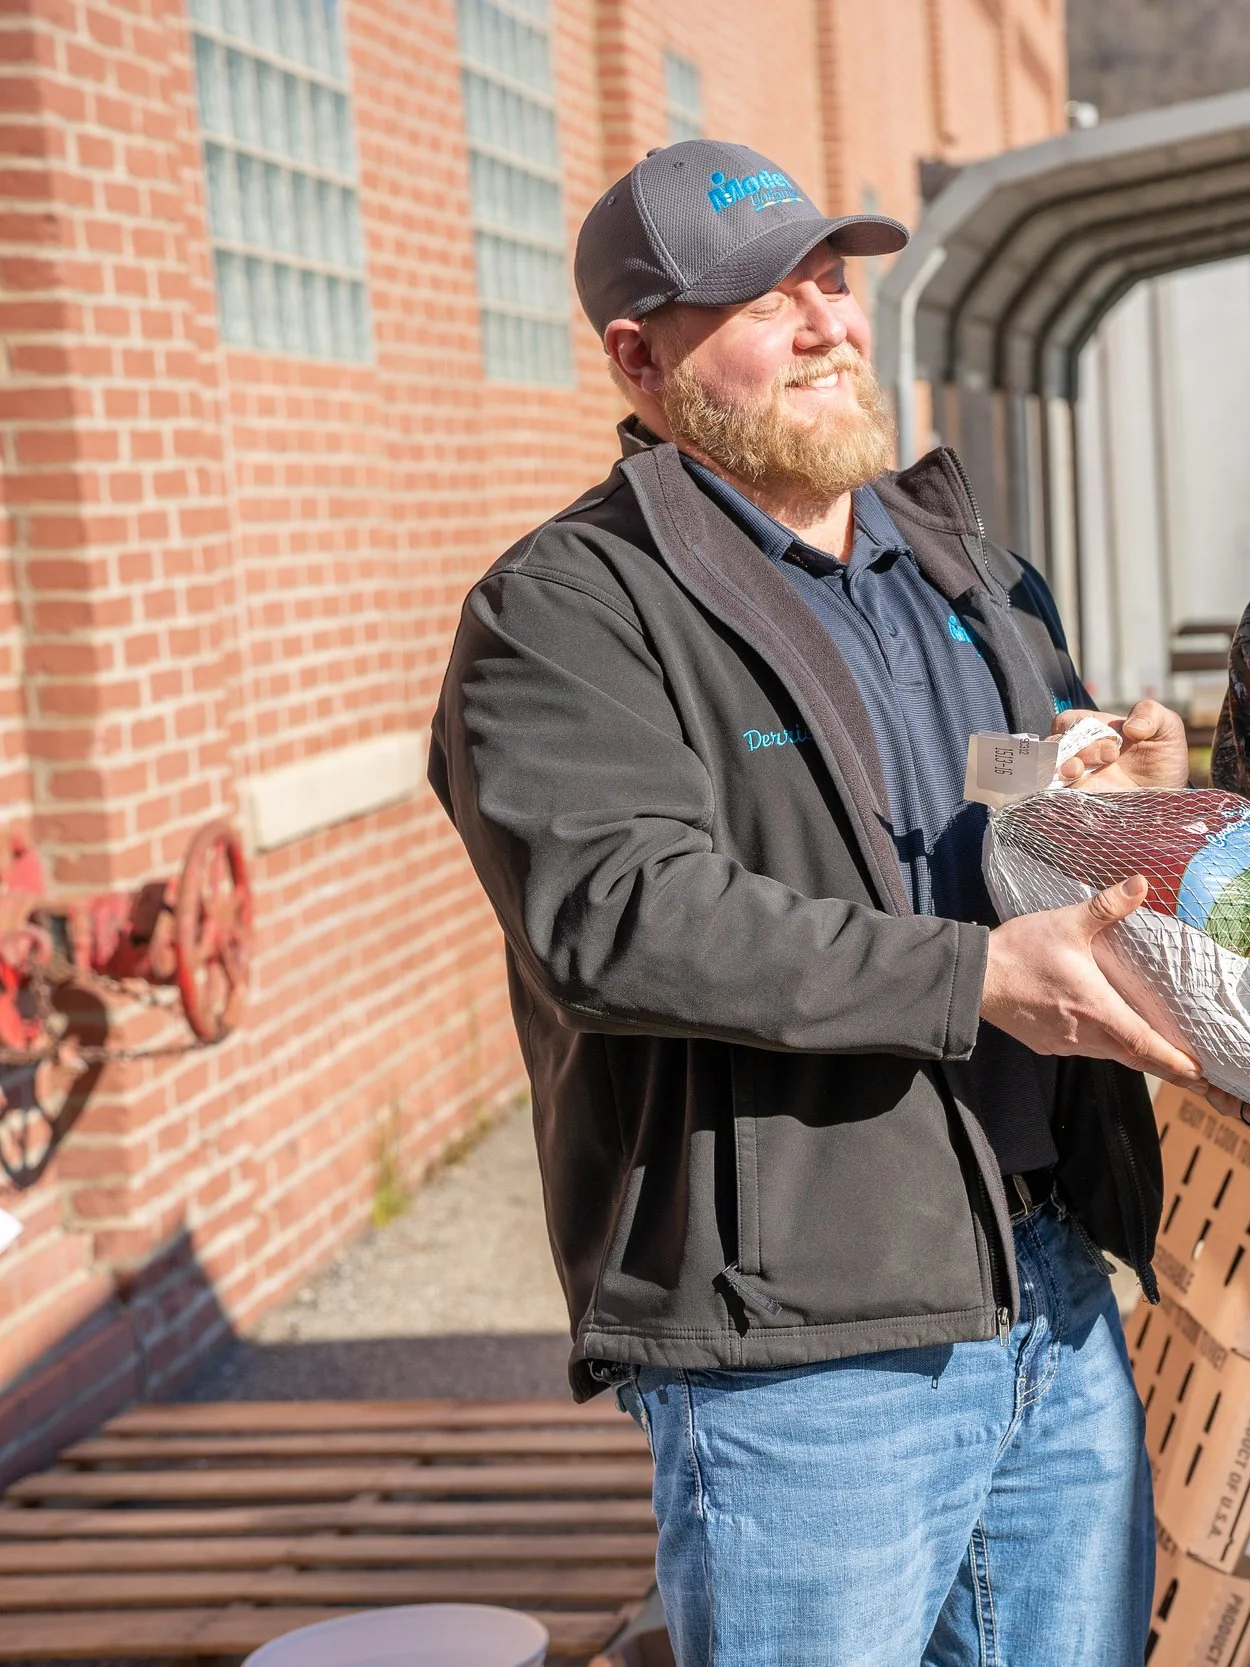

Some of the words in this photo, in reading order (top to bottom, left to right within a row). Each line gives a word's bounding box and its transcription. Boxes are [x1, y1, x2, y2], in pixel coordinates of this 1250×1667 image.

[994, 747, 1014, 776] 1513-16
[1226, 1471, 1242, 1493] OF
[1207, 1495, 1234, 1539] U.S.A.
[1205, 1591, 1245, 1665] PRODUCT
